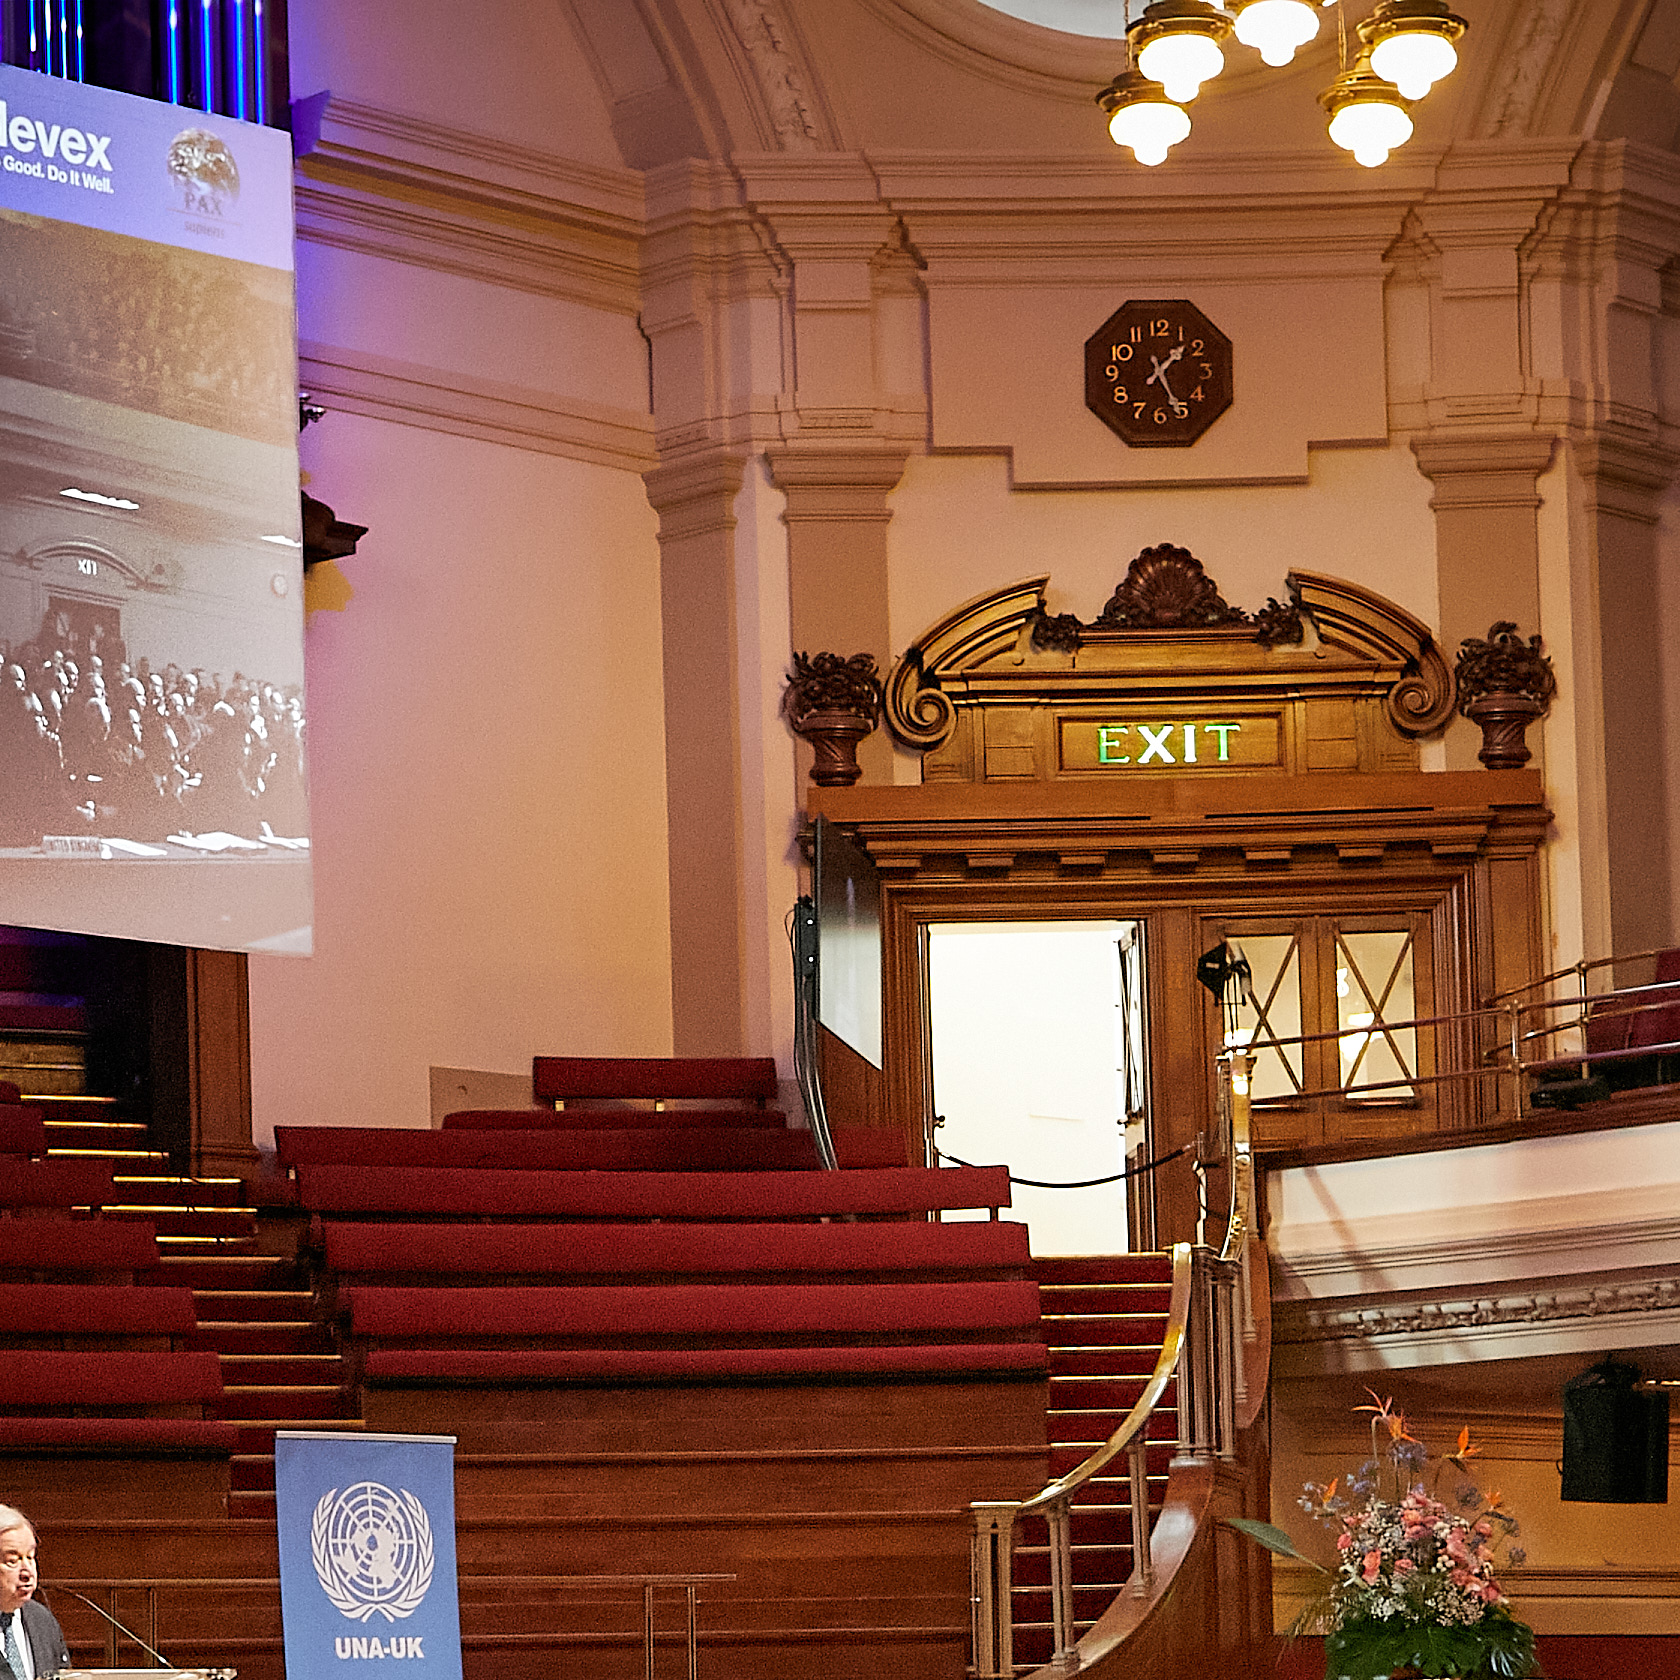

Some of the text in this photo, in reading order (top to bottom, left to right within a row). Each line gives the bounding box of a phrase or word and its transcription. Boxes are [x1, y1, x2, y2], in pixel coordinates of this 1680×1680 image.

[3, 155, 45, 178] Good.
[47, 164, 68, 184] Do
[70, 170, 81, 187] It
[82, 172, 115, 194] Well.
[184, 191, 223, 218] PAX
[1130, 326, 1142, 343] 11
[1150, 319, 1169, 337] 12
[1112, 344, 1133, 361] 10
[1192, 340, 1204, 357] 2
[1105, 365, 1119, 382] 9
[1199, 363, 1213, 380] 3
[1113, 386, 1129, 404] 8
[1190, 386, 1205, 402] 4
[1133, 402, 1147, 419] 7
[1153, 407, 1167, 424] 6
[1174, 402, 1189, 419] 5
[1097, 724, 1241, 764] EXIT
[334, 1636, 425, 1660] UNA-UK
